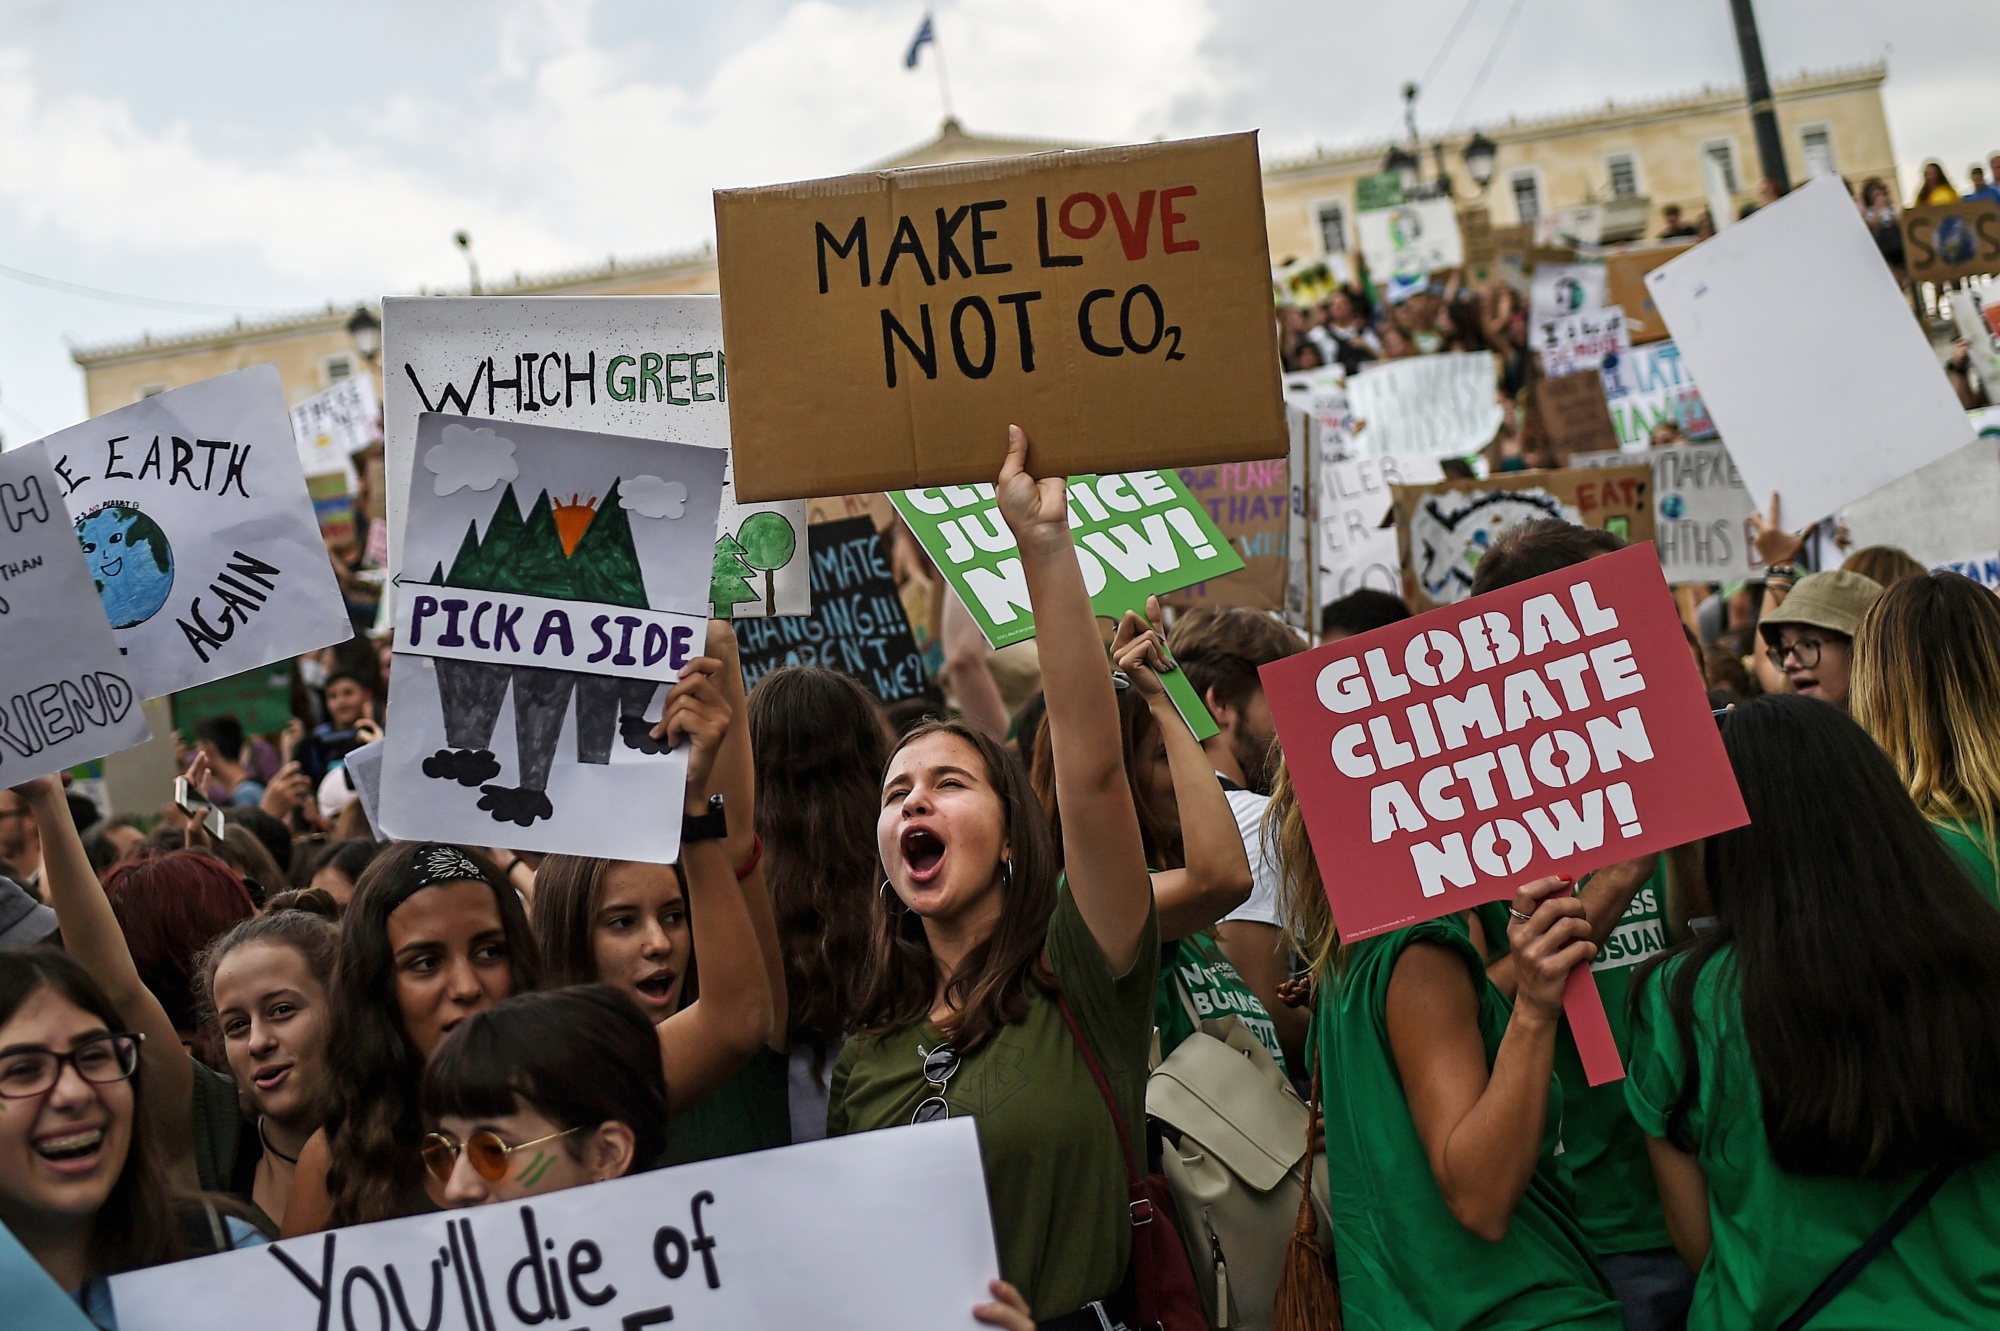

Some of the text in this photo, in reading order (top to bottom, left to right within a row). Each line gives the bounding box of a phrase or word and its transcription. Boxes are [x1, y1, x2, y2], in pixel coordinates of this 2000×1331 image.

[815, 185, 1200, 294] MAKE LOVE
[880, 291, 1042, 388] NOT
[405, 350, 596, 416] WHICH
[105, 435, 251, 498] EARTH
[1321, 455, 1413, 501] ILER:
[1575, 476, 1646, 513] EAT!
[1207, 494, 1287, 525] THAT
[0, 555, 43, 581] THAN
[809, 534, 893, 592] IMATE
[176, 550, 281, 663] AGAIN
[410, 595, 694, 671] PICK A SIDE
[872, 653, 925, 700] WE?
[1315, 581, 1619, 714] GLOBAL
[0, 671, 132, 758] RIEND
[1330, 639, 1646, 779] CLIMATE
[1369, 706, 1655, 844] ACTION
[1409, 782, 1643, 898] NOW!
[267, 1190, 721, 1331] You'll die of
